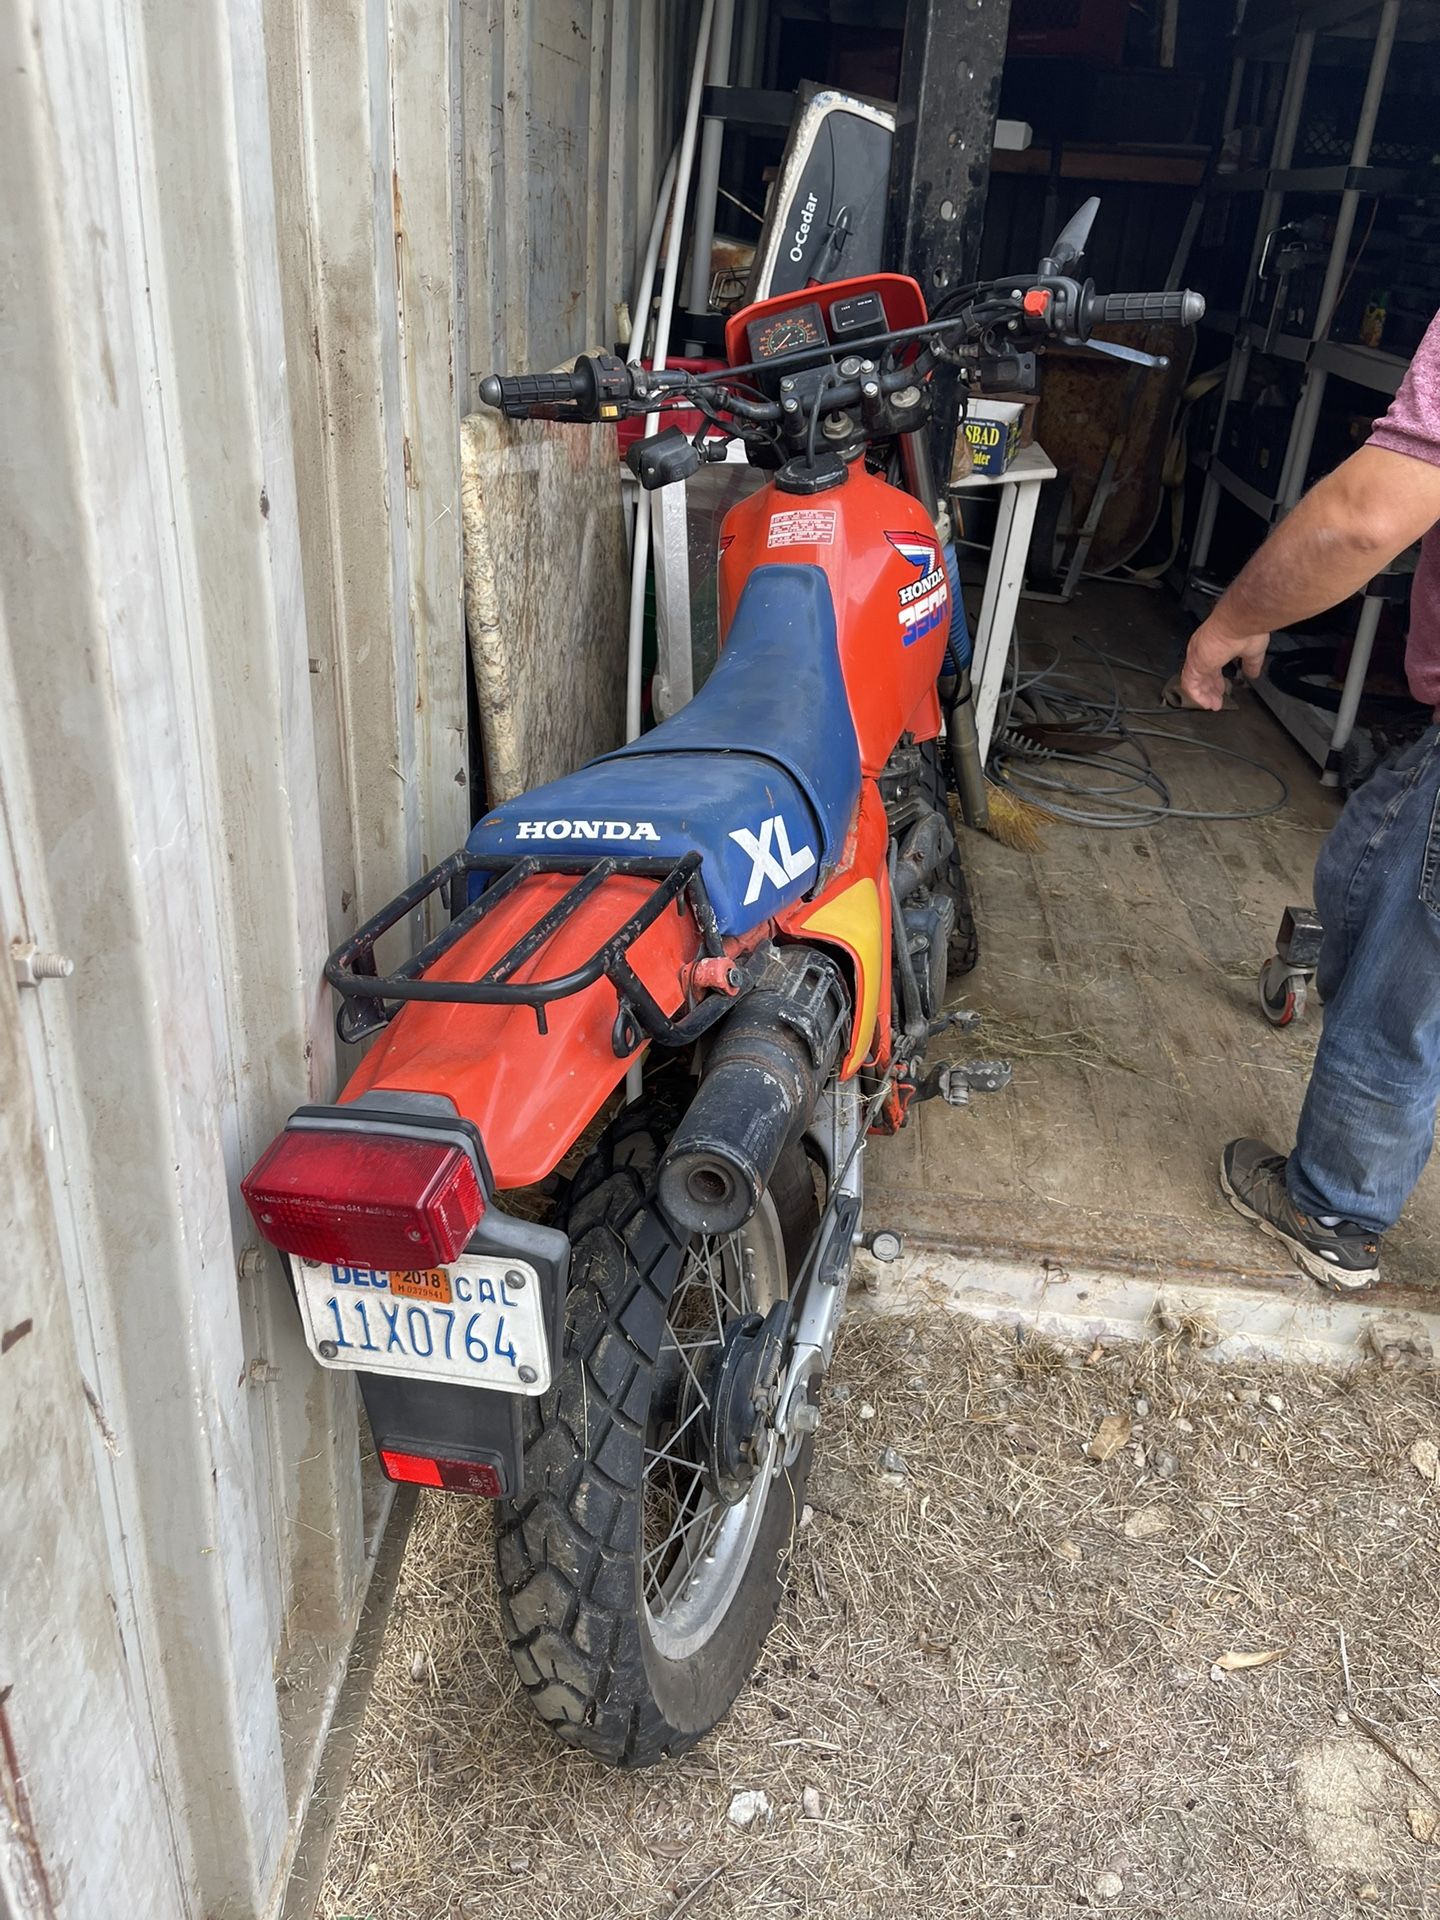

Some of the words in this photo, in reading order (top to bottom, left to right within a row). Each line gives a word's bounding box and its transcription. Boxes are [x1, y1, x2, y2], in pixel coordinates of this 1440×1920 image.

[899, 569, 944, 605] HONDA
[516, 820, 661, 841] HONDA
[728, 814, 816, 906] XL
[332, 1266, 388, 1289] DEC
[403, 1271, 440, 1289] 2018
[456, 1276, 518, 1307] CAL
[327, 1297, 516, 1367] 11X0764
